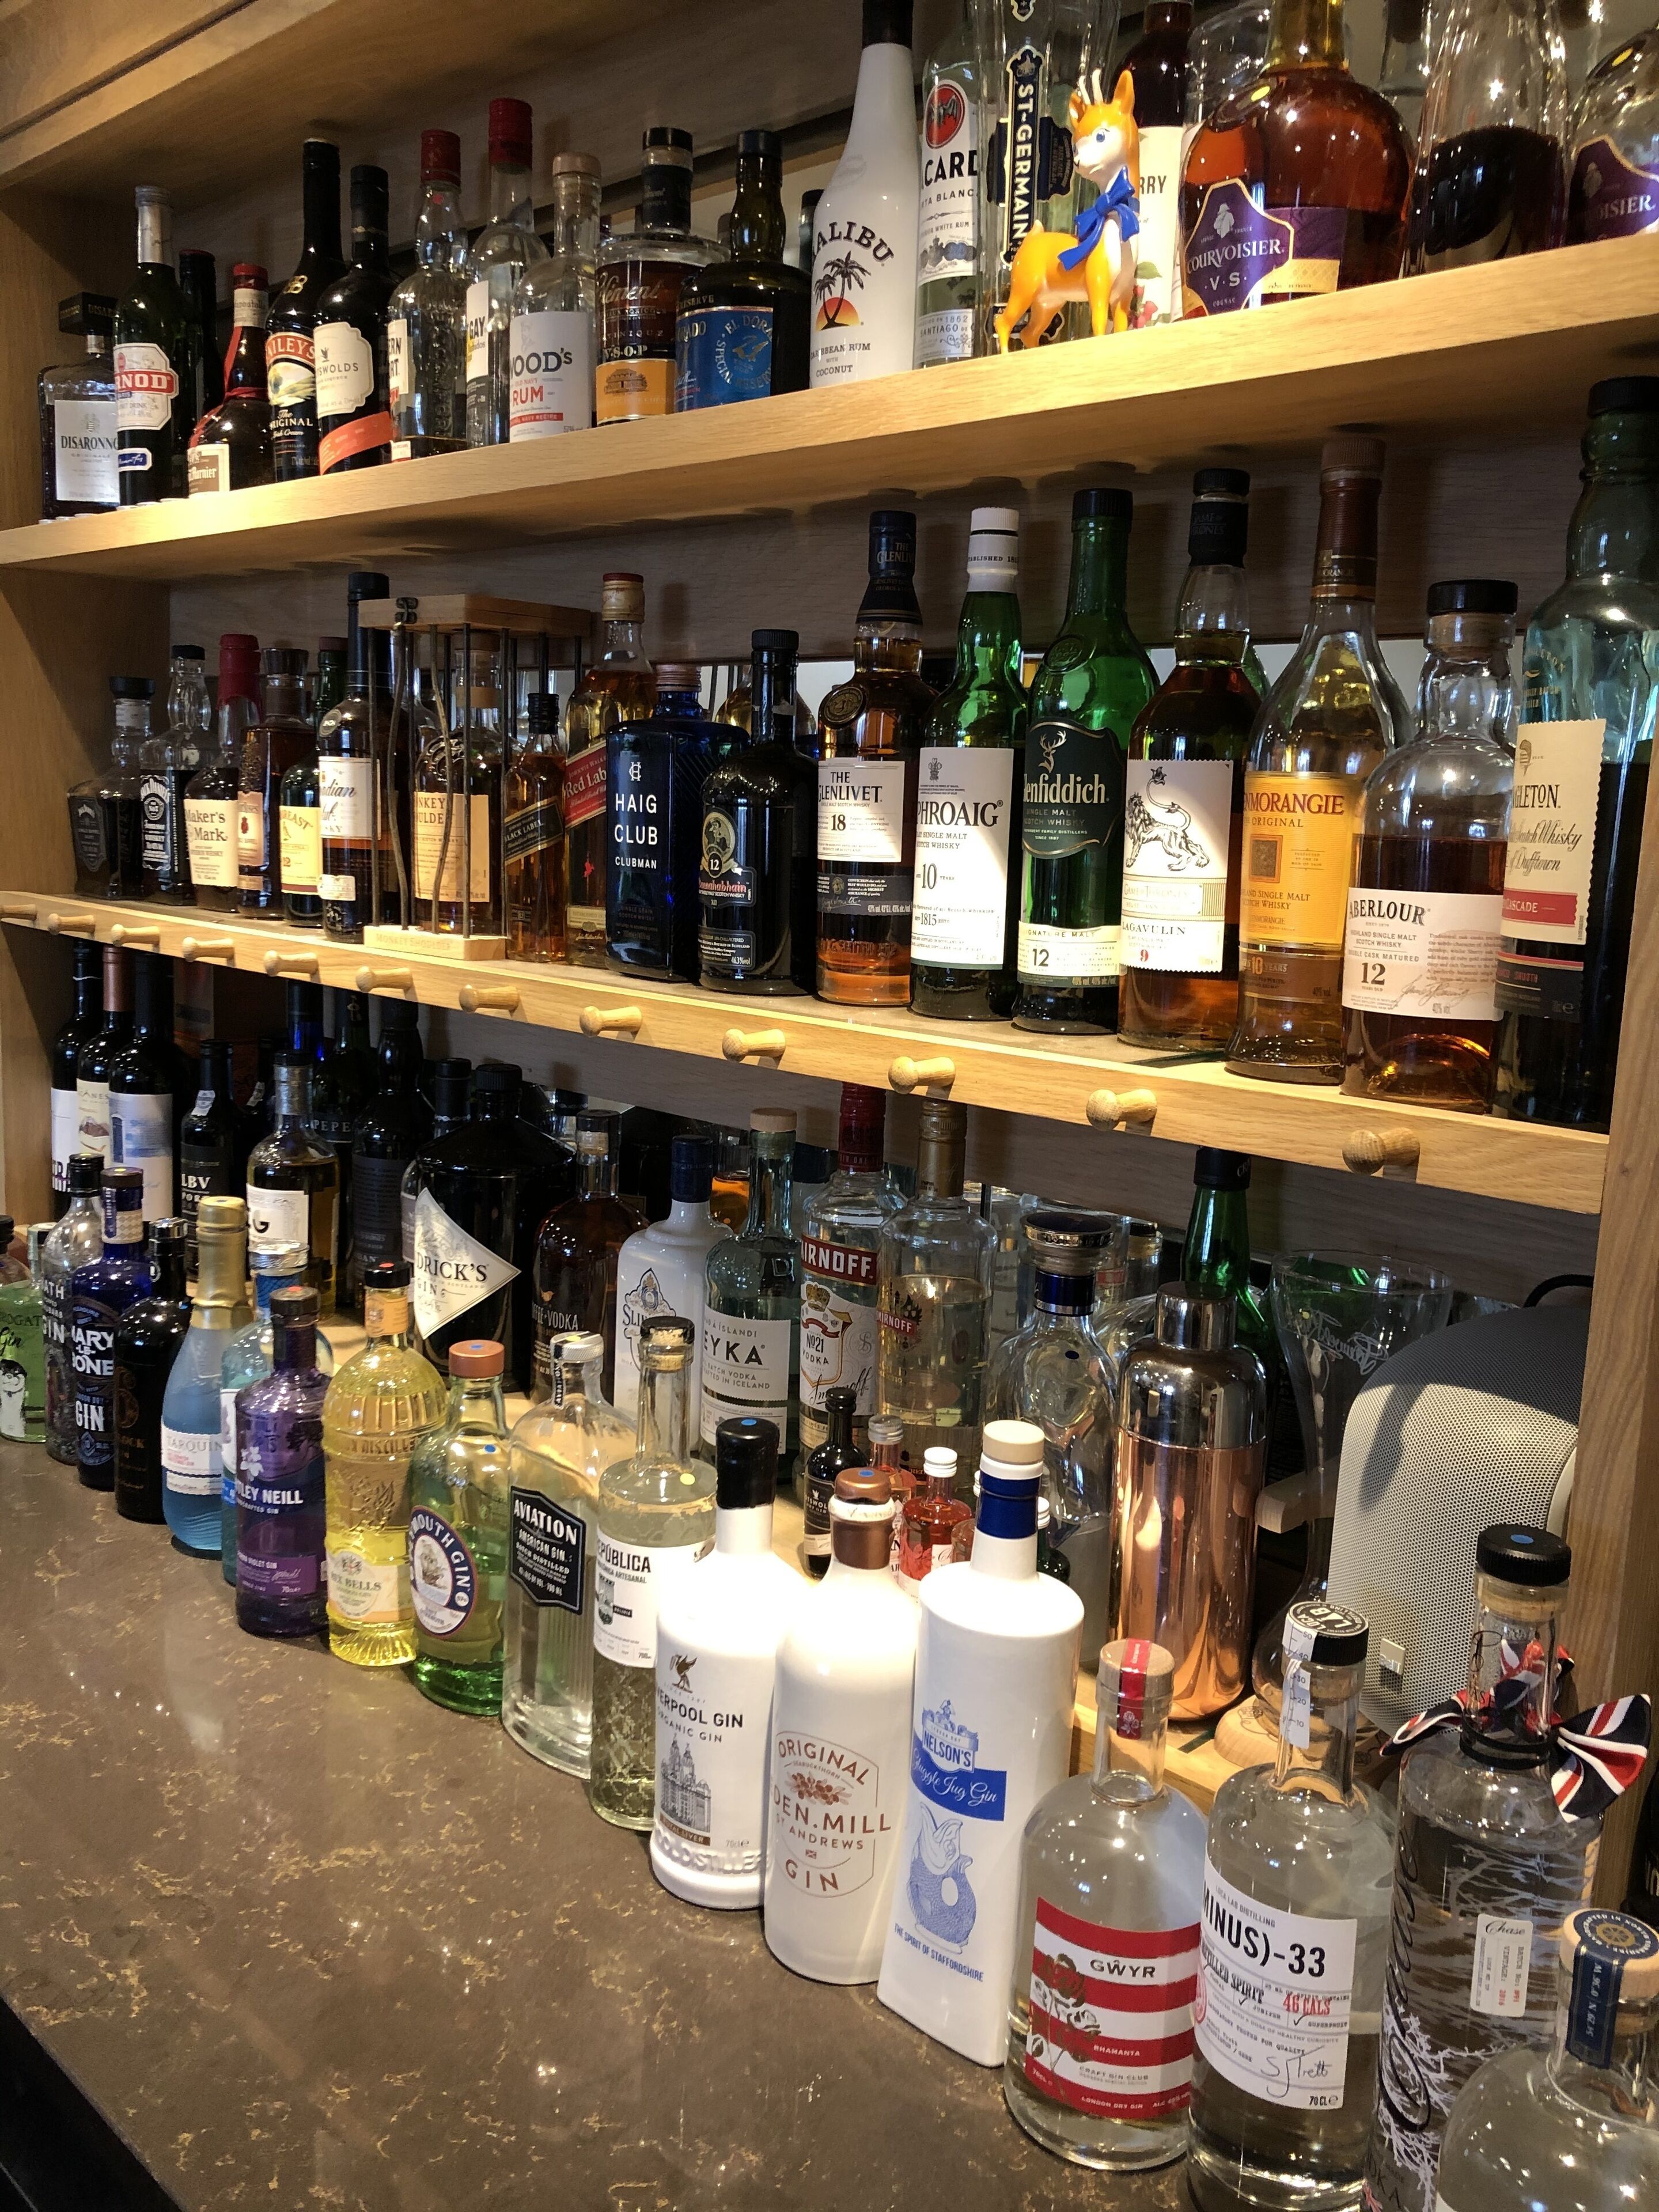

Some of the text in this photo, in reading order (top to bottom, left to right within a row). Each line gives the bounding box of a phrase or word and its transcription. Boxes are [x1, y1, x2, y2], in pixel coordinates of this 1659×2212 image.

[922, 150, 978, 190] CARD
[937, 189, 978, 202] BLANC
[813, 221, 894, 263] ALIBU
[1188, 238, 1283, 274] COURVOISIER
[469, 316, 486, 338] GAY
[266, 337, 315, 359] AILEYS
[849, 343, 870, 351] RUM
[816, 364, 853, 377] COCONUT
[116, 374, 169, 389] RNOD
[513, 385, 543, 407] RUM
[896, 541, 909, 551] THE
[565, 777, 585, 798] Red
[588, 767, 607, 788] Lab
[831, 771, 850, 783] THE
[1024, 772, 1106, 804] lenfiddich
[615, 793, 657, 813] HAIG
[831, 813, 846, 831] 18
[1252, 817, 1304, 828] ORIGINAL
[615, 824, 658, 845] CLUB
[615, 856, 657, 870] CLUBMAN
[710, 859, 719, 871] 12
[922, 863, 938, 886] 10
[1258, 890, 1310, 902] SINGLE MALT
[1262, 900, 1291, 910] WHISKY
[1349, 899, 1425, 926] ABERLOUR
[921, 912, 937, 926] 1815
[1122, 921, 1186, 935] LAGAVULIN
[1372, 931, 1396, 940] SINGLE
[1397, 933, 1417, 941] MALT
[1376, 940, 1402, 948] WHISKY
[1032, 948, 1050, 967] 12
[1140, 949, 1149, 963] 9
[1382, 953, 1419, 962] MATURED
[1361, 962, 1387, 986] 12
[181, 1173, 211, 1190] LBV
[418, 1251, 488, 1282] DRICK'S
[44, 1280, 65, 1300] ATH
[547, 1310, 578, 1331] VODKA
[704, 1330, 763, 1366] EYKA
[802, 1349, 830, 1365] VODKA
[728, 1370, 757, 1381] VODKA
[733, 1378, 771, 1389] ICELAND
[75, 1400, 105, 1432] GIN
[262, 1489, 304, 1505] NEILL
[513, 1498, 577, 1546] AVIATION
[551, 1545, 567, 1562] GIN
[450, 1550, 471, 1588] GIN
[532, 1553, 570, 1575] DISTILLED
[1302, 1630, 1313, 1640] 50
[1296, 1676, 1306, 1684] 30
[1297, 1697, 1306, 1706] 20
[713, 1712, 744, 1728] GIN
[1296, 1719, 1304, 1728] 10
[699, 1731, 722, 1743] GIN
[923, 1730, 972, 1768] NELSON'S
[778, 1738, 869, 1786] ORIGINAL
[934, 1775, 966, 1802] Jug
[969, 1782, 999, 1807] Gin
[789, 1824, 864, 1851] ANDREWS
[785, 1858, 839, 1892] GIN
[1239, 1903, 1275, 1927] DISTILLING
[1485, 1920, 1526, 1936] Chase
[894, 1922, 984, 1983] THE SPIRIT OF STAFFORDSHIRE
[1230, 1972, 1264, 2005] SPIRIT
[1283, 1993, 1331, 2016] 46 CALS
[1275, 2043, 1305, 2056] QUALITY
[1081, 2096, 1112, 2108] LONDON
